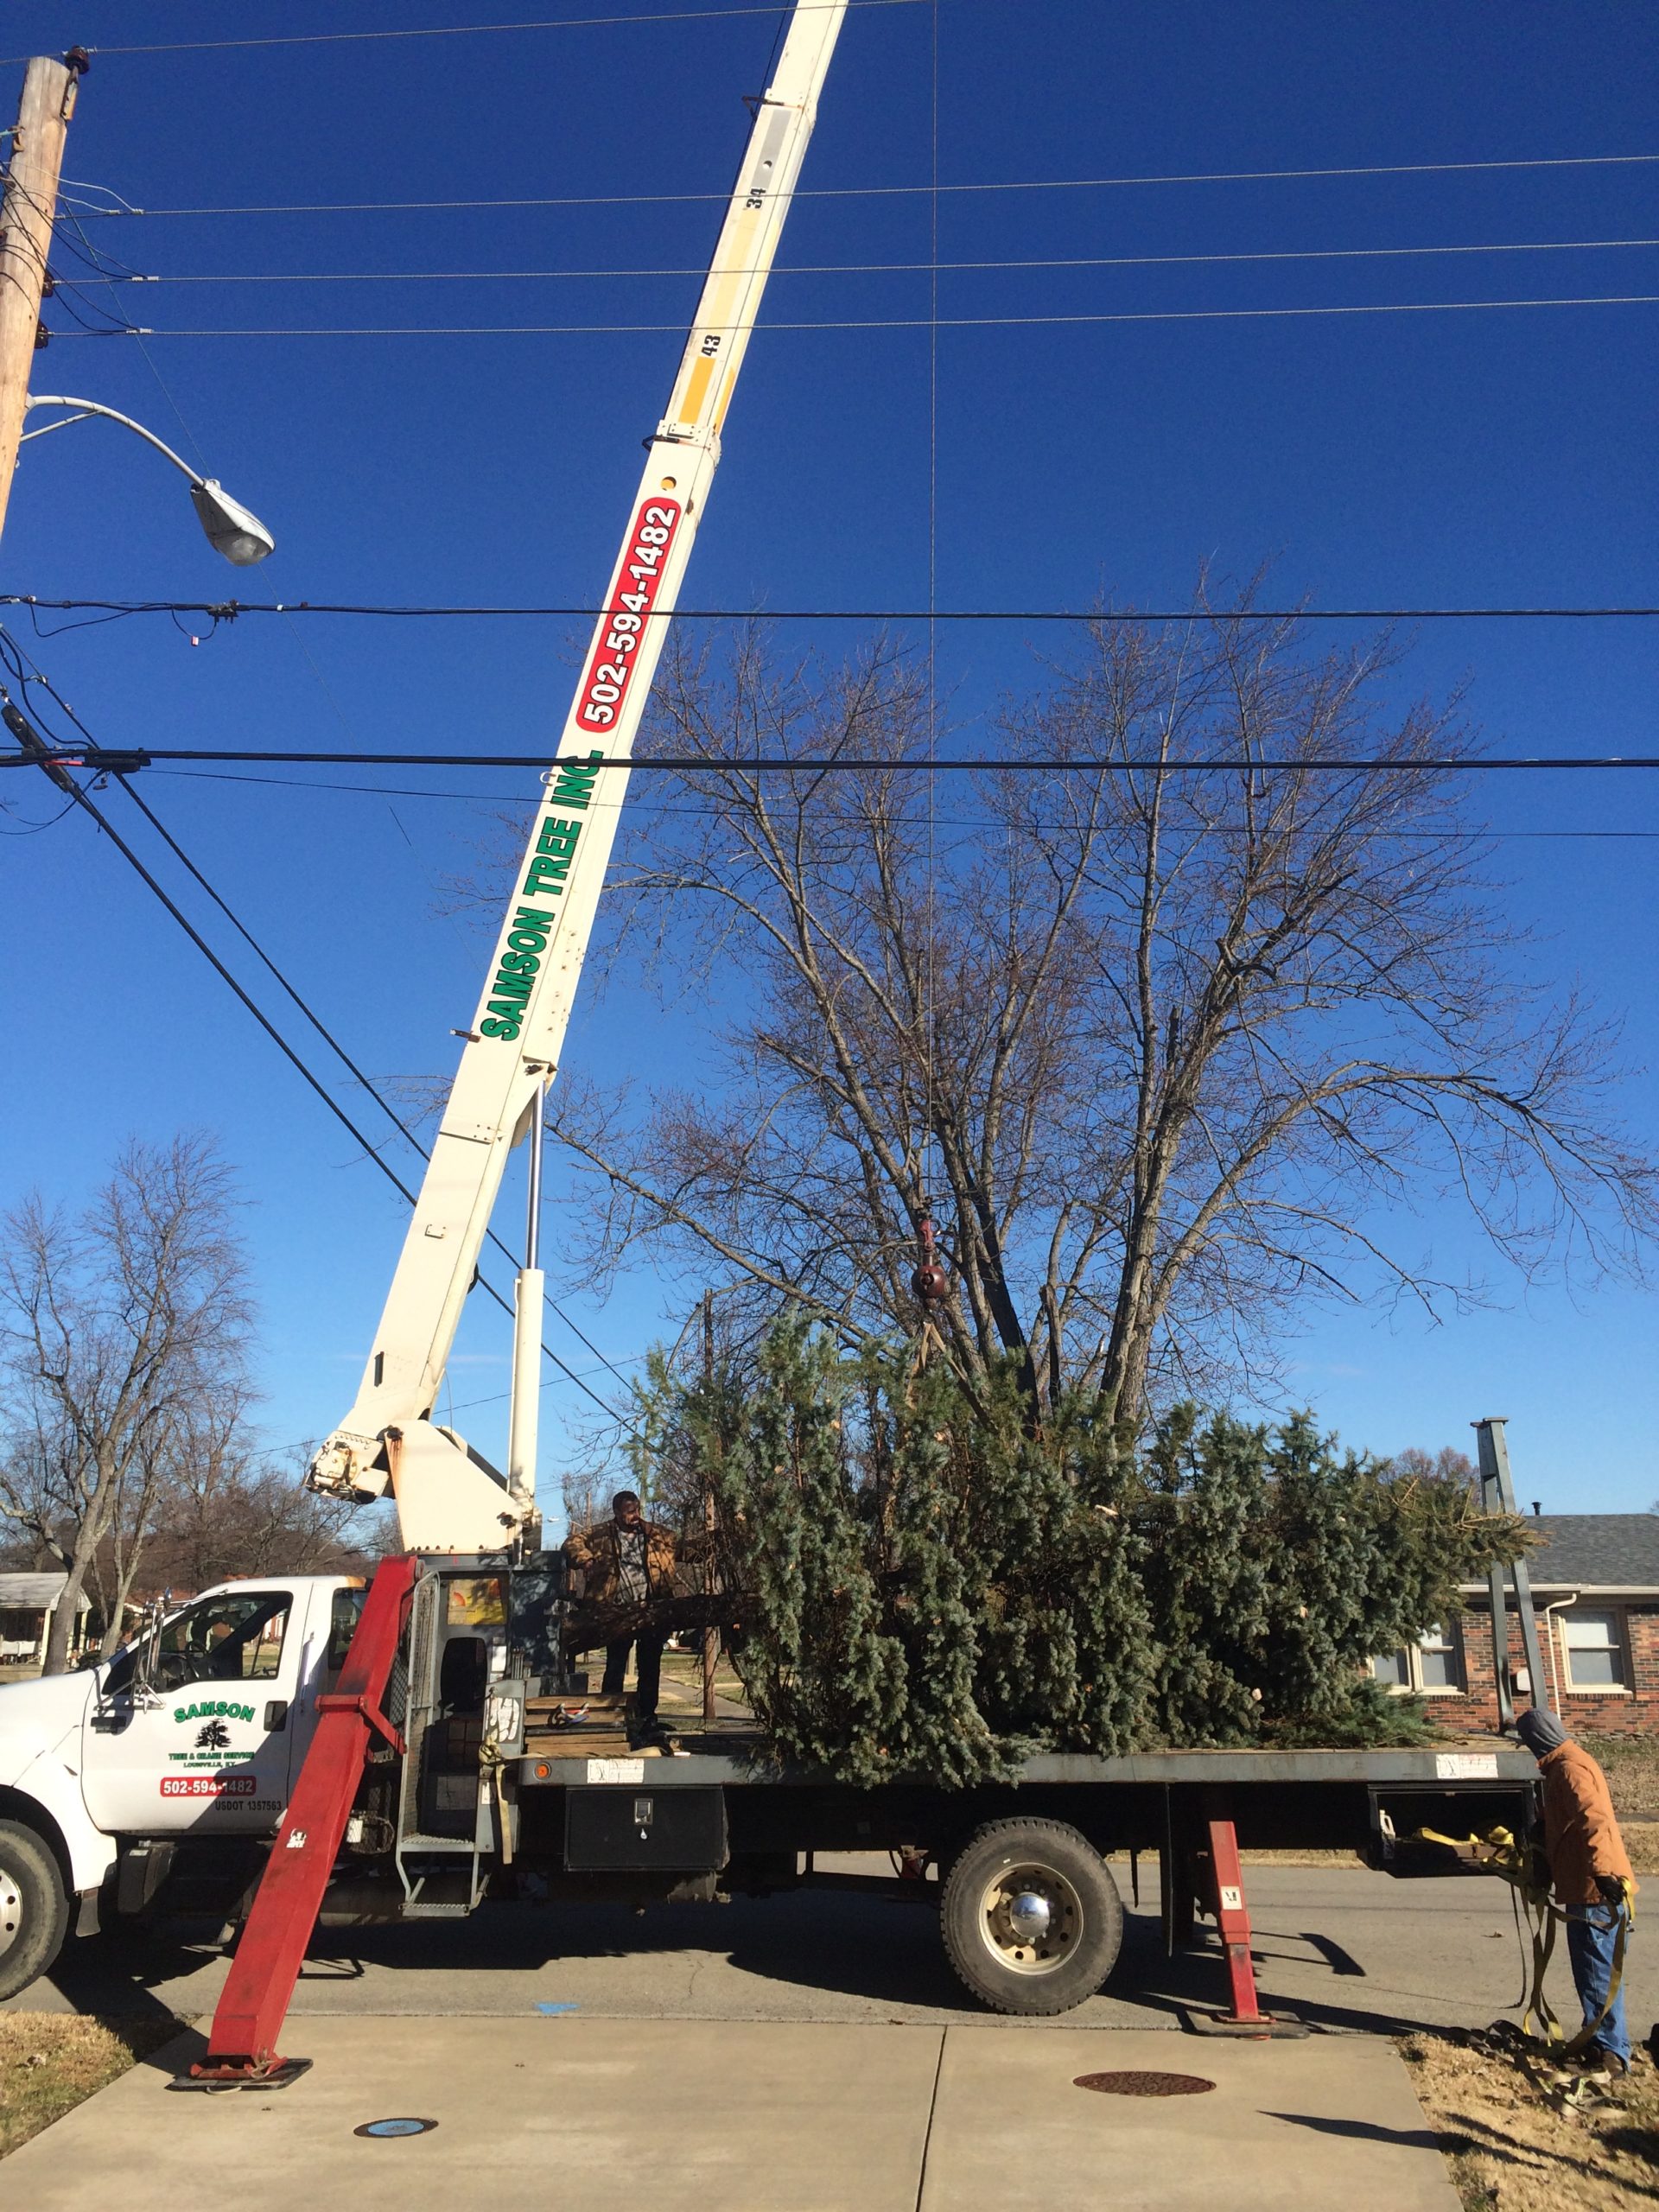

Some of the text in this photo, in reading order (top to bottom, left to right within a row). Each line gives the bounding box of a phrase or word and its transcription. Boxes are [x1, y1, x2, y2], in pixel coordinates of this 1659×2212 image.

[746, 188, 766, 209] 34
[701, 334, 721, 357] 43
[583, 505, 677, 725] 502-594-1482
[480, 906, 556, 1041] SAMSON
[523, 817, 583, 896] TREE
[174, 1701, 256, 1723] SAMSON
[163, 1780, 253, 1794] 502-594-1482
[215, 1801, 244, 1810] USDOT
